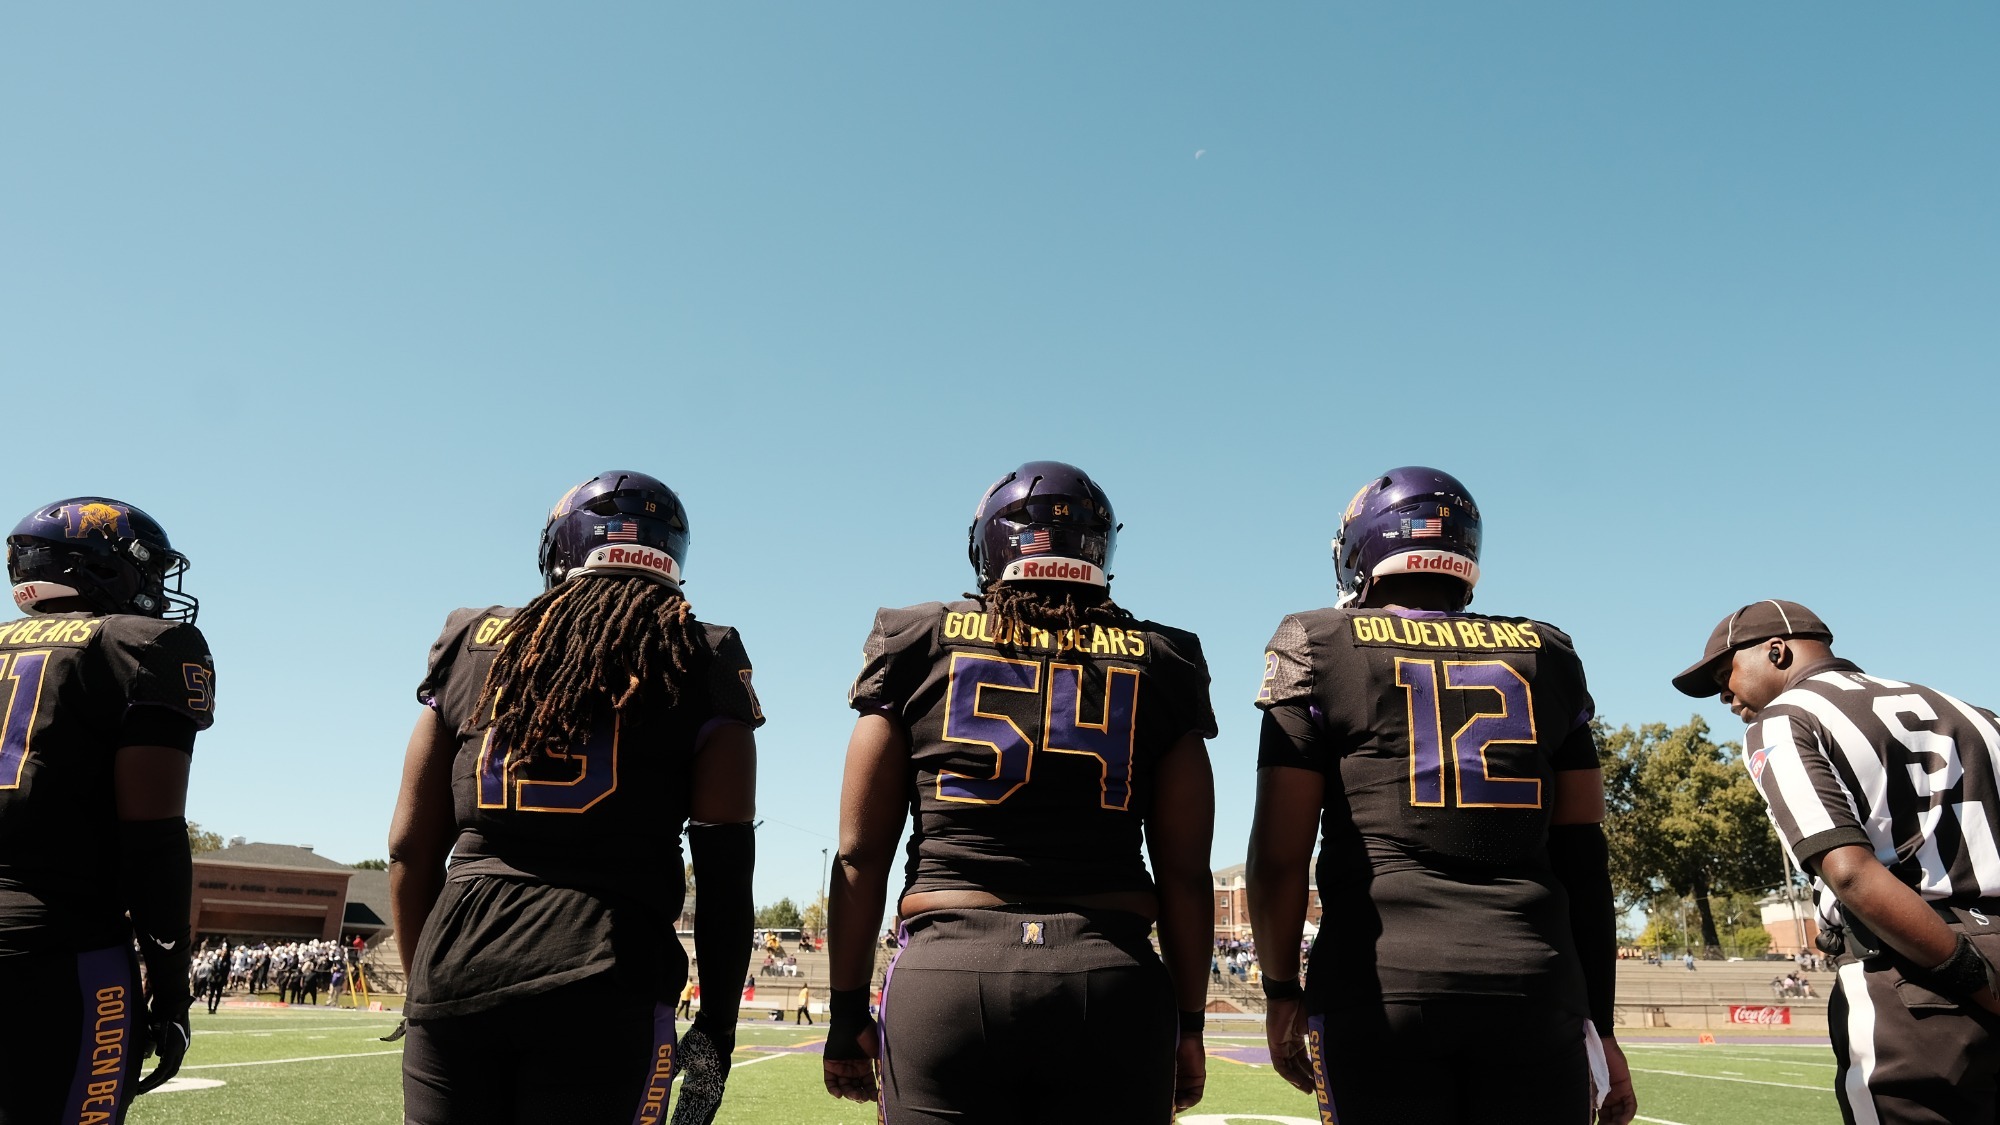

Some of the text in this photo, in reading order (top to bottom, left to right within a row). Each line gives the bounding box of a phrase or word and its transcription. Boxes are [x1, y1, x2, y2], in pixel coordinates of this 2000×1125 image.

[644, 501, 656, 513] 19
[1054, 504, 1069, 516] 54
[1439, 506, 1450, 517] 16
[608, 548, 673, 574] Riddell
[1023, 561, 1092, 581] Riddell
[1406, 554, 1473, 578] Riddell
[8, 619, 101, 644] BEARS
[1353, 616, 1542, 649] GOLDEN BEARS
[0, 650, 53, 790] 1
[935, 651, 1140, 811] 54
[1394, 656, 1543, 809] 12
[1872, 693, 1964, 797] S
[1969, 907, 1990, 926] S
[92, 985, 125, 1076] GOLDEN
[1309, 1030, 1329, 1104] BEARS
